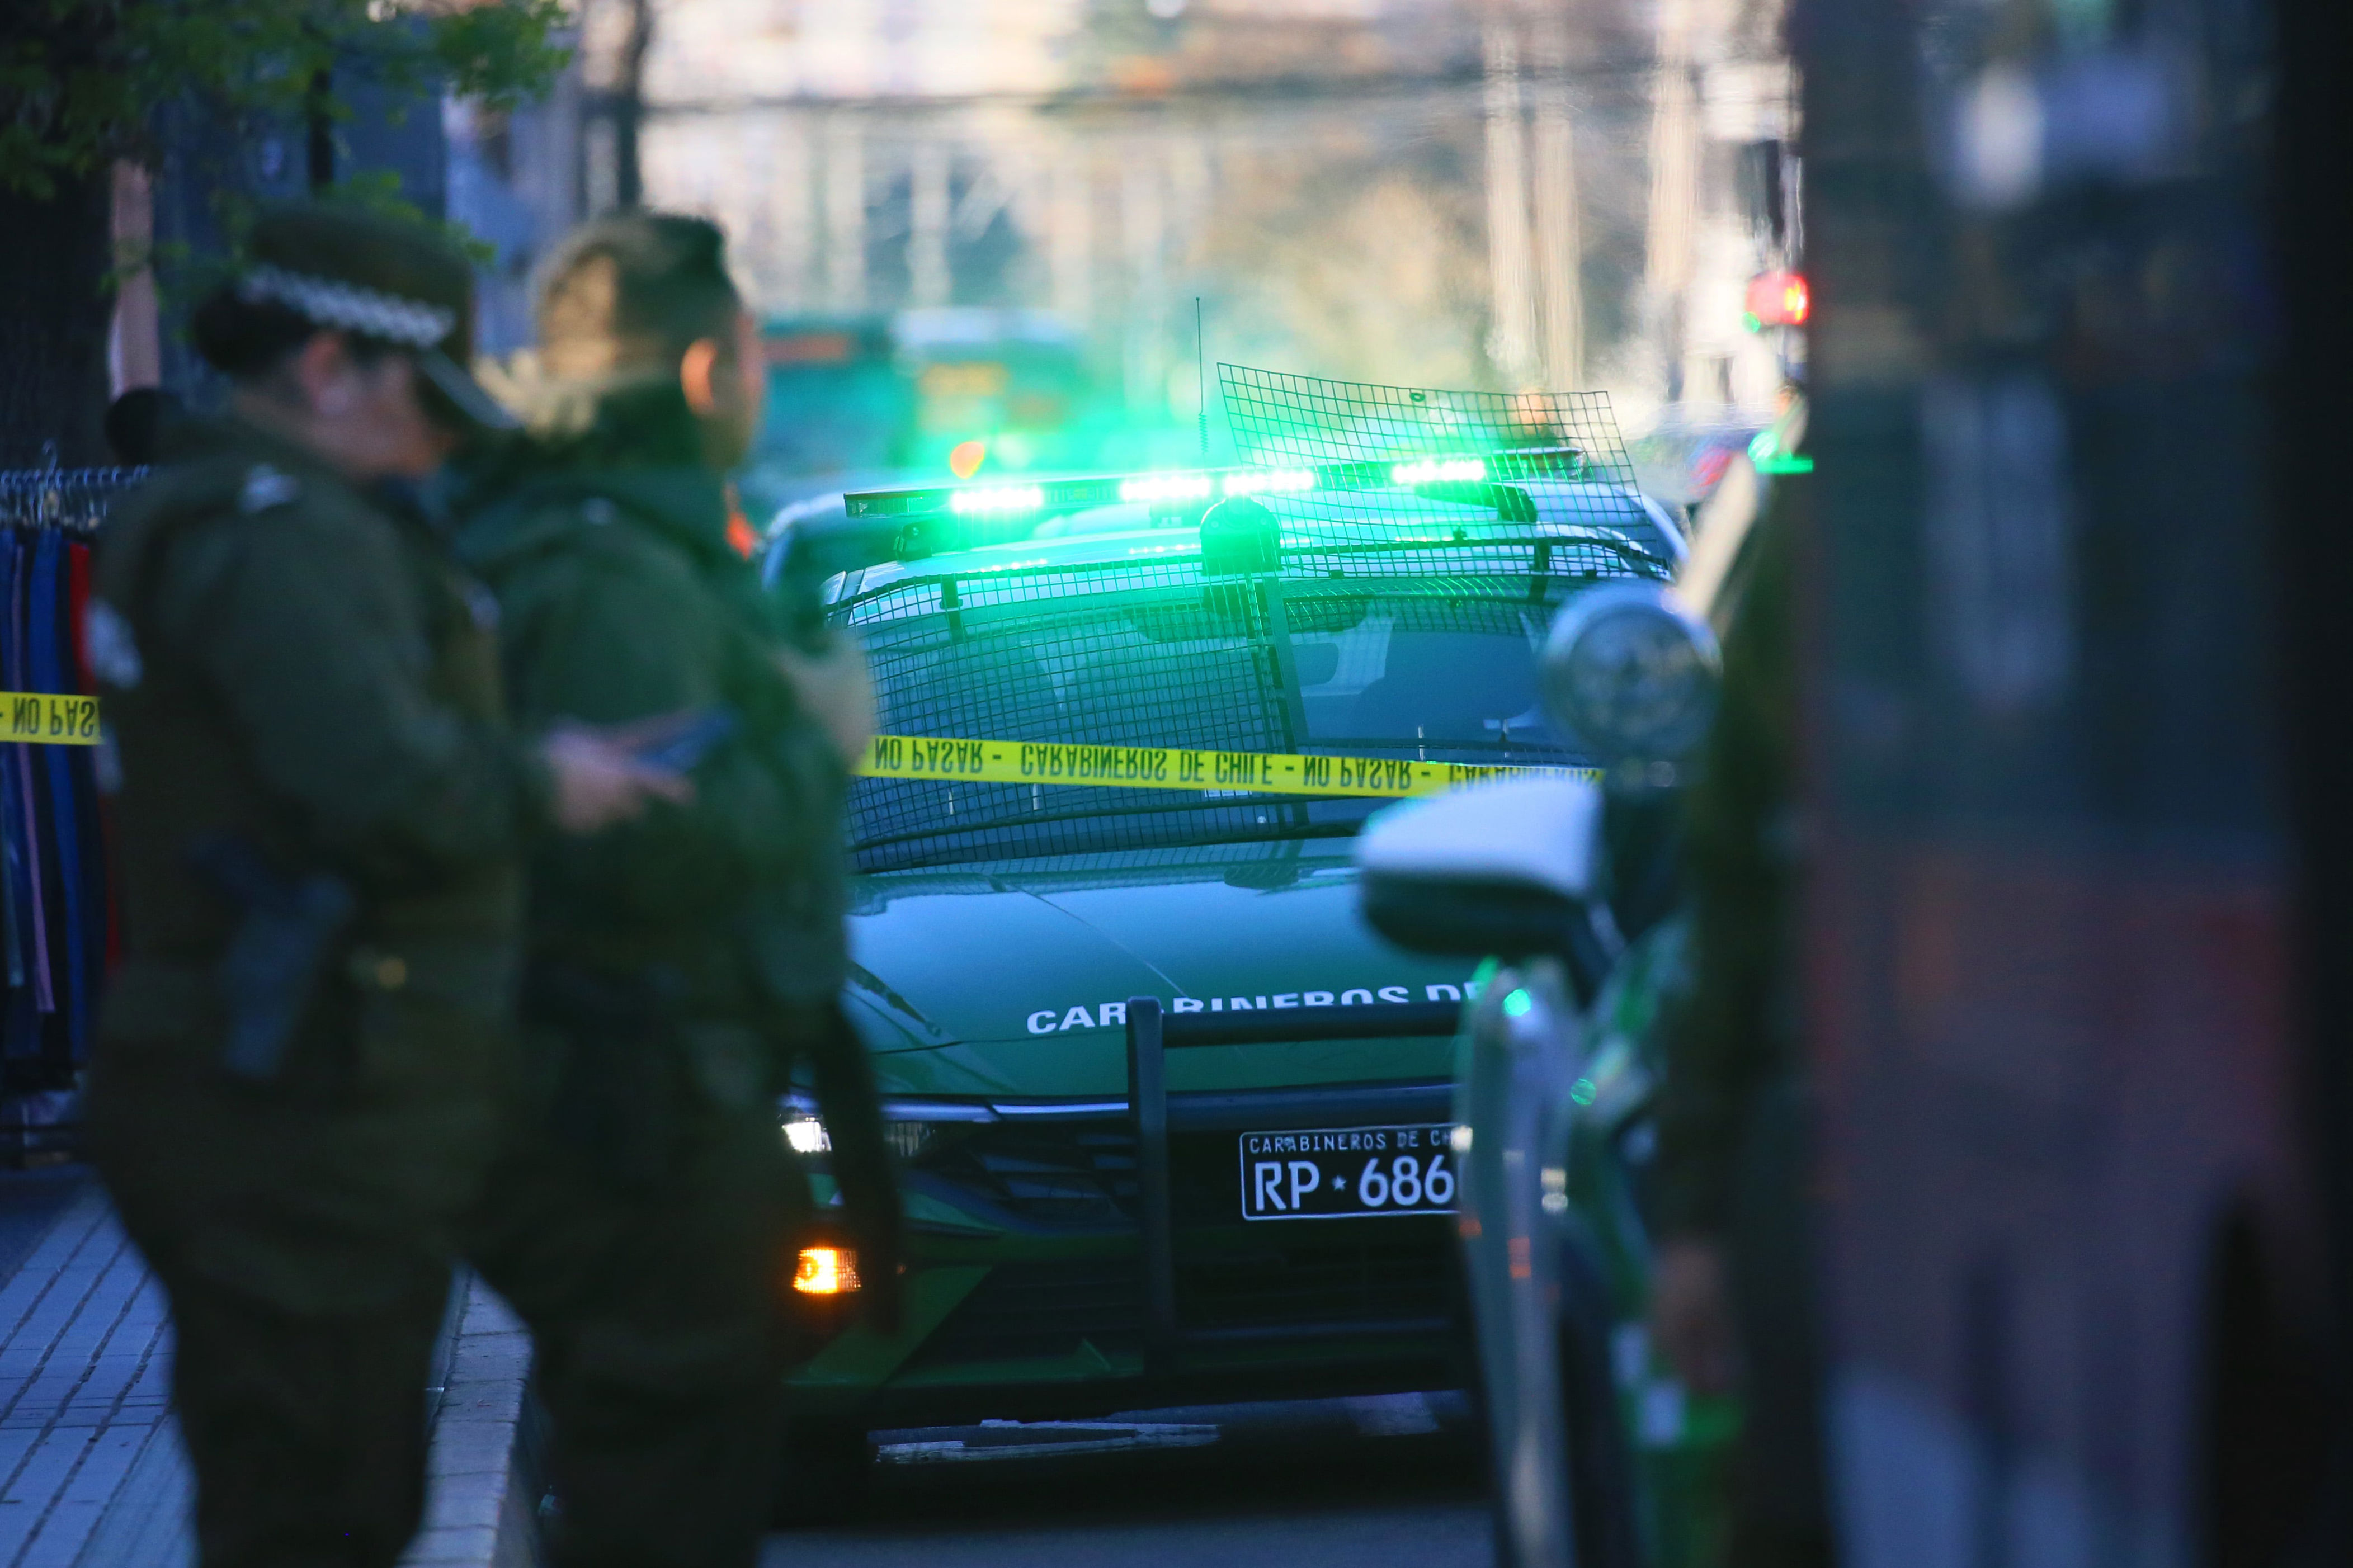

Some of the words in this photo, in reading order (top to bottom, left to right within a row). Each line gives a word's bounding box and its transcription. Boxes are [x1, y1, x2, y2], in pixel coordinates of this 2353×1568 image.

[1027, 986, 1409, 1034] CARBINEROS
[1249, 1133, 1387, 1154] CARABINEROS
[1398, 1130, 1418, 1147] DE
[1255, 1160, 1320, 1211] RP
